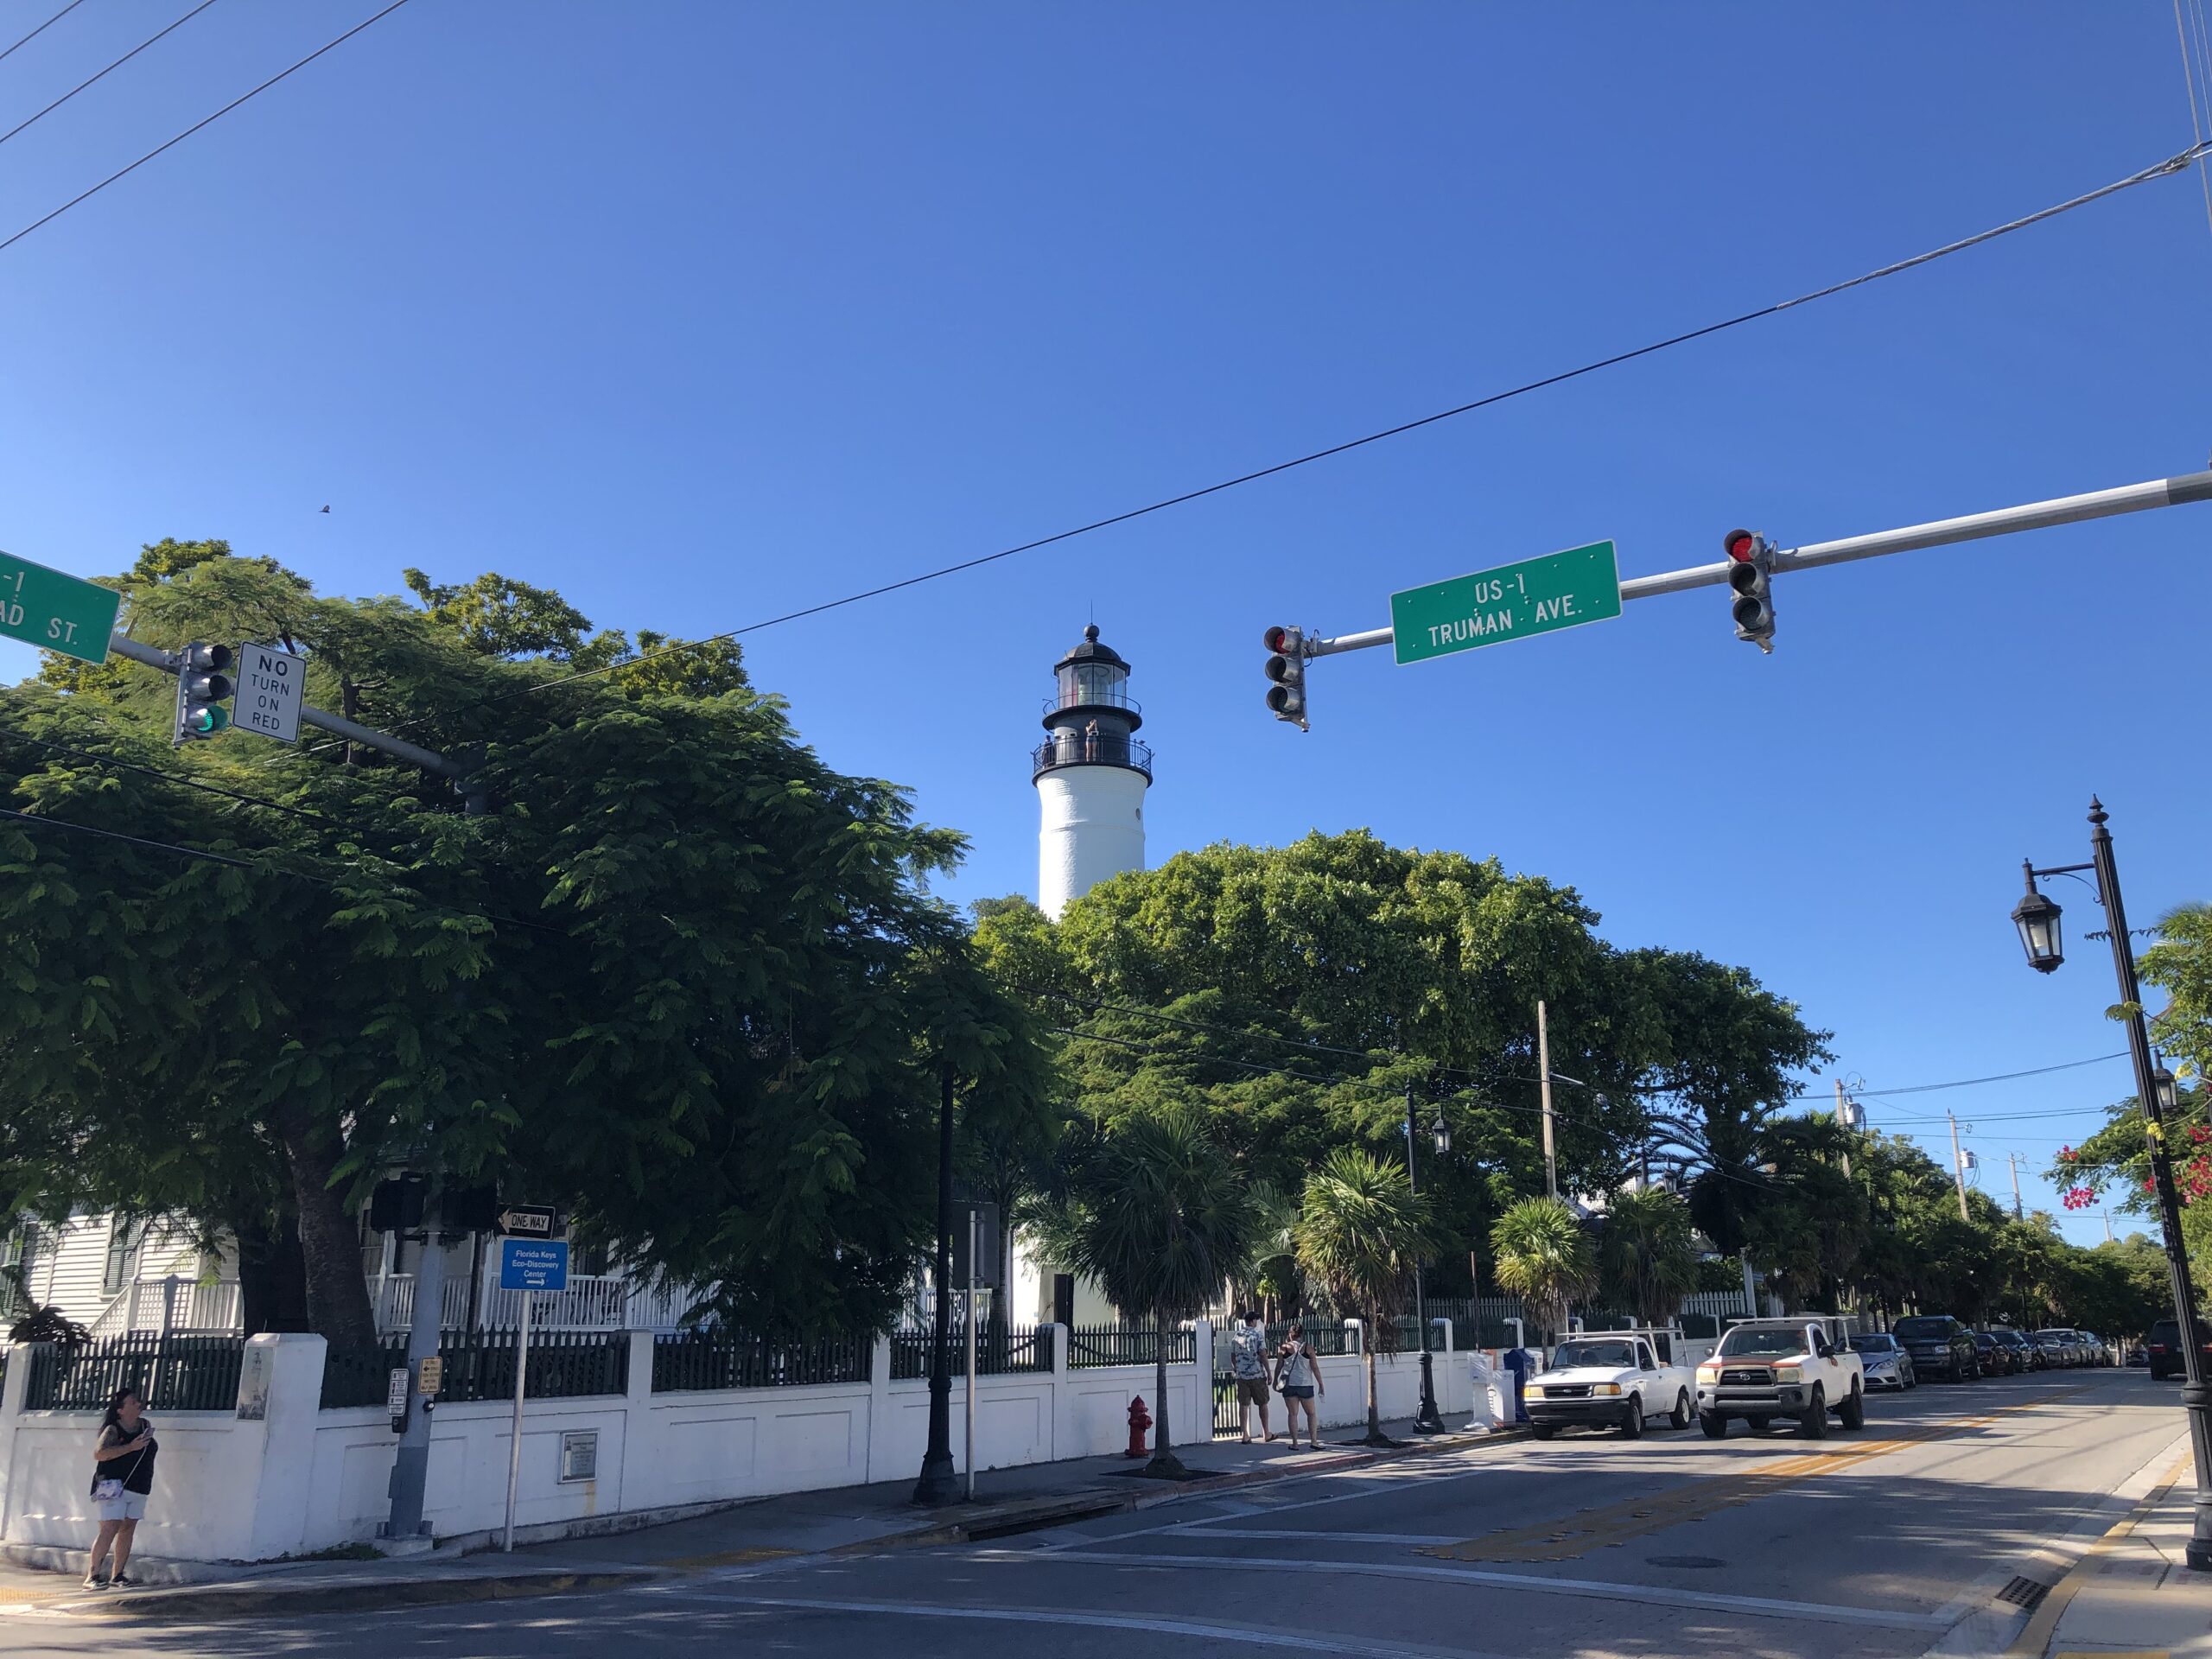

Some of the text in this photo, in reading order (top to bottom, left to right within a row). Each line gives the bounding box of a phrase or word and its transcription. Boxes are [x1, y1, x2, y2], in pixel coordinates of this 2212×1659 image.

[1475, 574, 1525, 603] US-1
[1427, 594, 1582, 646] TRUMAN AVE.
[48, 617, 78, 645] ST.
[258, 654, 288, 677] NO
[251, 673, 289, 696] TURN
[257, 695, 279, 712] ON
[251, 711, 280, 730] RED
[512, 1214, 547, 1230] ONE WAY
[516, 1249, 557, 1261] Florida Keys
[512, 1260, 560, 1270] Eco-Discovery
[524, 1269, 547, 1278] Center
